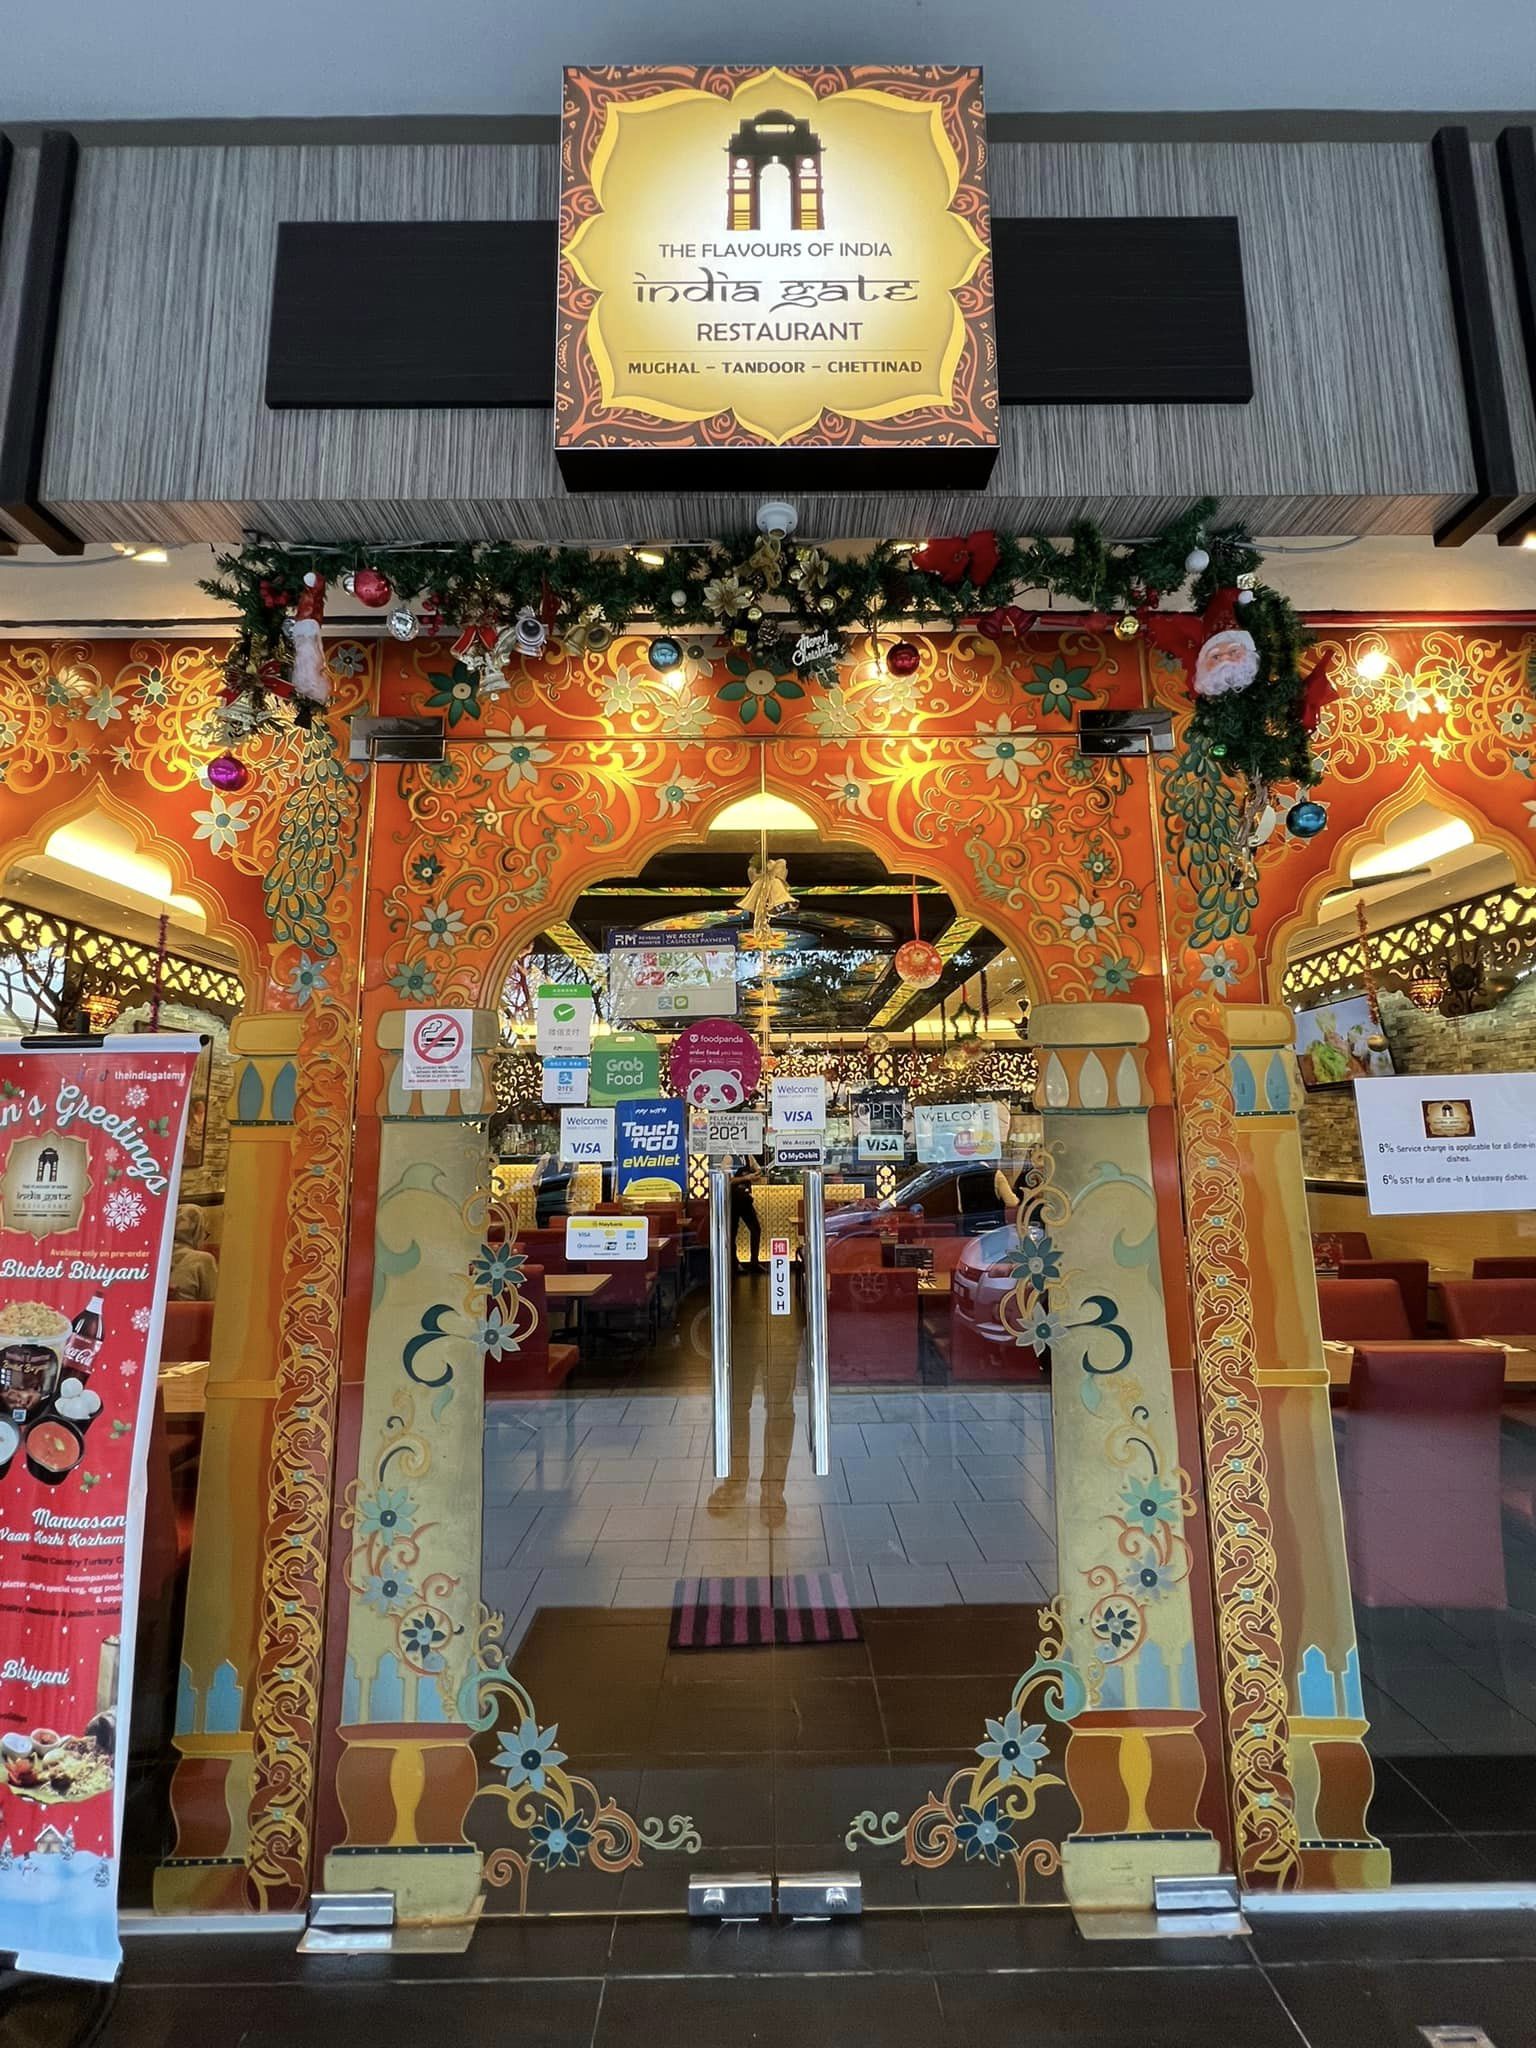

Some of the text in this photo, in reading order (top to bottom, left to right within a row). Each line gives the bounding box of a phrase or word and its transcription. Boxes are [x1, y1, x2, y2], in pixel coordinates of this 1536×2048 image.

[659, 242, 892, 258] THE FLAVOURS OF INDIA
[632, 267, 920, 313] india gate
[697, 322, 864, 342] RESTAURANT
[628, 362, 701, 374] MUGHAL
[722, 362, 805, 374] TANDOOR
[828, 361, 923, 374] CHETTINAD
[700, 1034, 744, 1043] foodpanda
[606, 1057, 644, 1072] Grab
[114, 1071, 186, 1082] theindiagatemy
[606, 1072, 644, 1085] Food
[777, 1085, 819, 1094] Welcome
[784, 1111, 813, 1122] VISA
[858, 1103, 904, 1119] OPEN
[566, 1117, 609, 1126] Welcome
[622, 1121, 680, 1137] Touch
[710, 1127, 747, 1140] 2021
[55, 1083, 168, 1196] Greetings
[866, 1139, 898, 1151] VISA
[572, 1143, 601, 1154] VISA
[1378, 1142, 1394, 1153] 8%
[1396, 1145, 1422, 1153] Service
[1423, 1144, 1446, 1154] charge
[1456, 1143, 1490, 1153] applicable
[1491, 1142, 1501, 1150] for
[1503, 1142, 1511, 1150] all
[1512, 1141, 1536, 1149] dine-in
[623, 1154, 681, 1168] eWallet
[788, 1152, 818, 1161] MyDebit
[1446, 1155, 1471, 1163] dishes.
[1382, 1174, 1399, 1185] 6%
[1399, 1176, 1413, 1185] SST
[1415, 1176, 1425, 1184] for
[1426, 1176, 1435, 1184] all
[1436, 1175, 1451, 1184] dine
[1465, 1175, 1471, 1183] &
[1471, 1174, 1503, 1184] takeaway
[1504, 1173, 1529, 1182] dishes.
[111, 1250, 150, 1259] pre-order
[0, 1259, 150, 1287] Bucket Biriyani
[776, 1259, 785, 1311] PUSH
[0, 1527, 126, 1548] Vaan Kozhi Kozham
[1, 1657, 70, 1687] Biriyani
